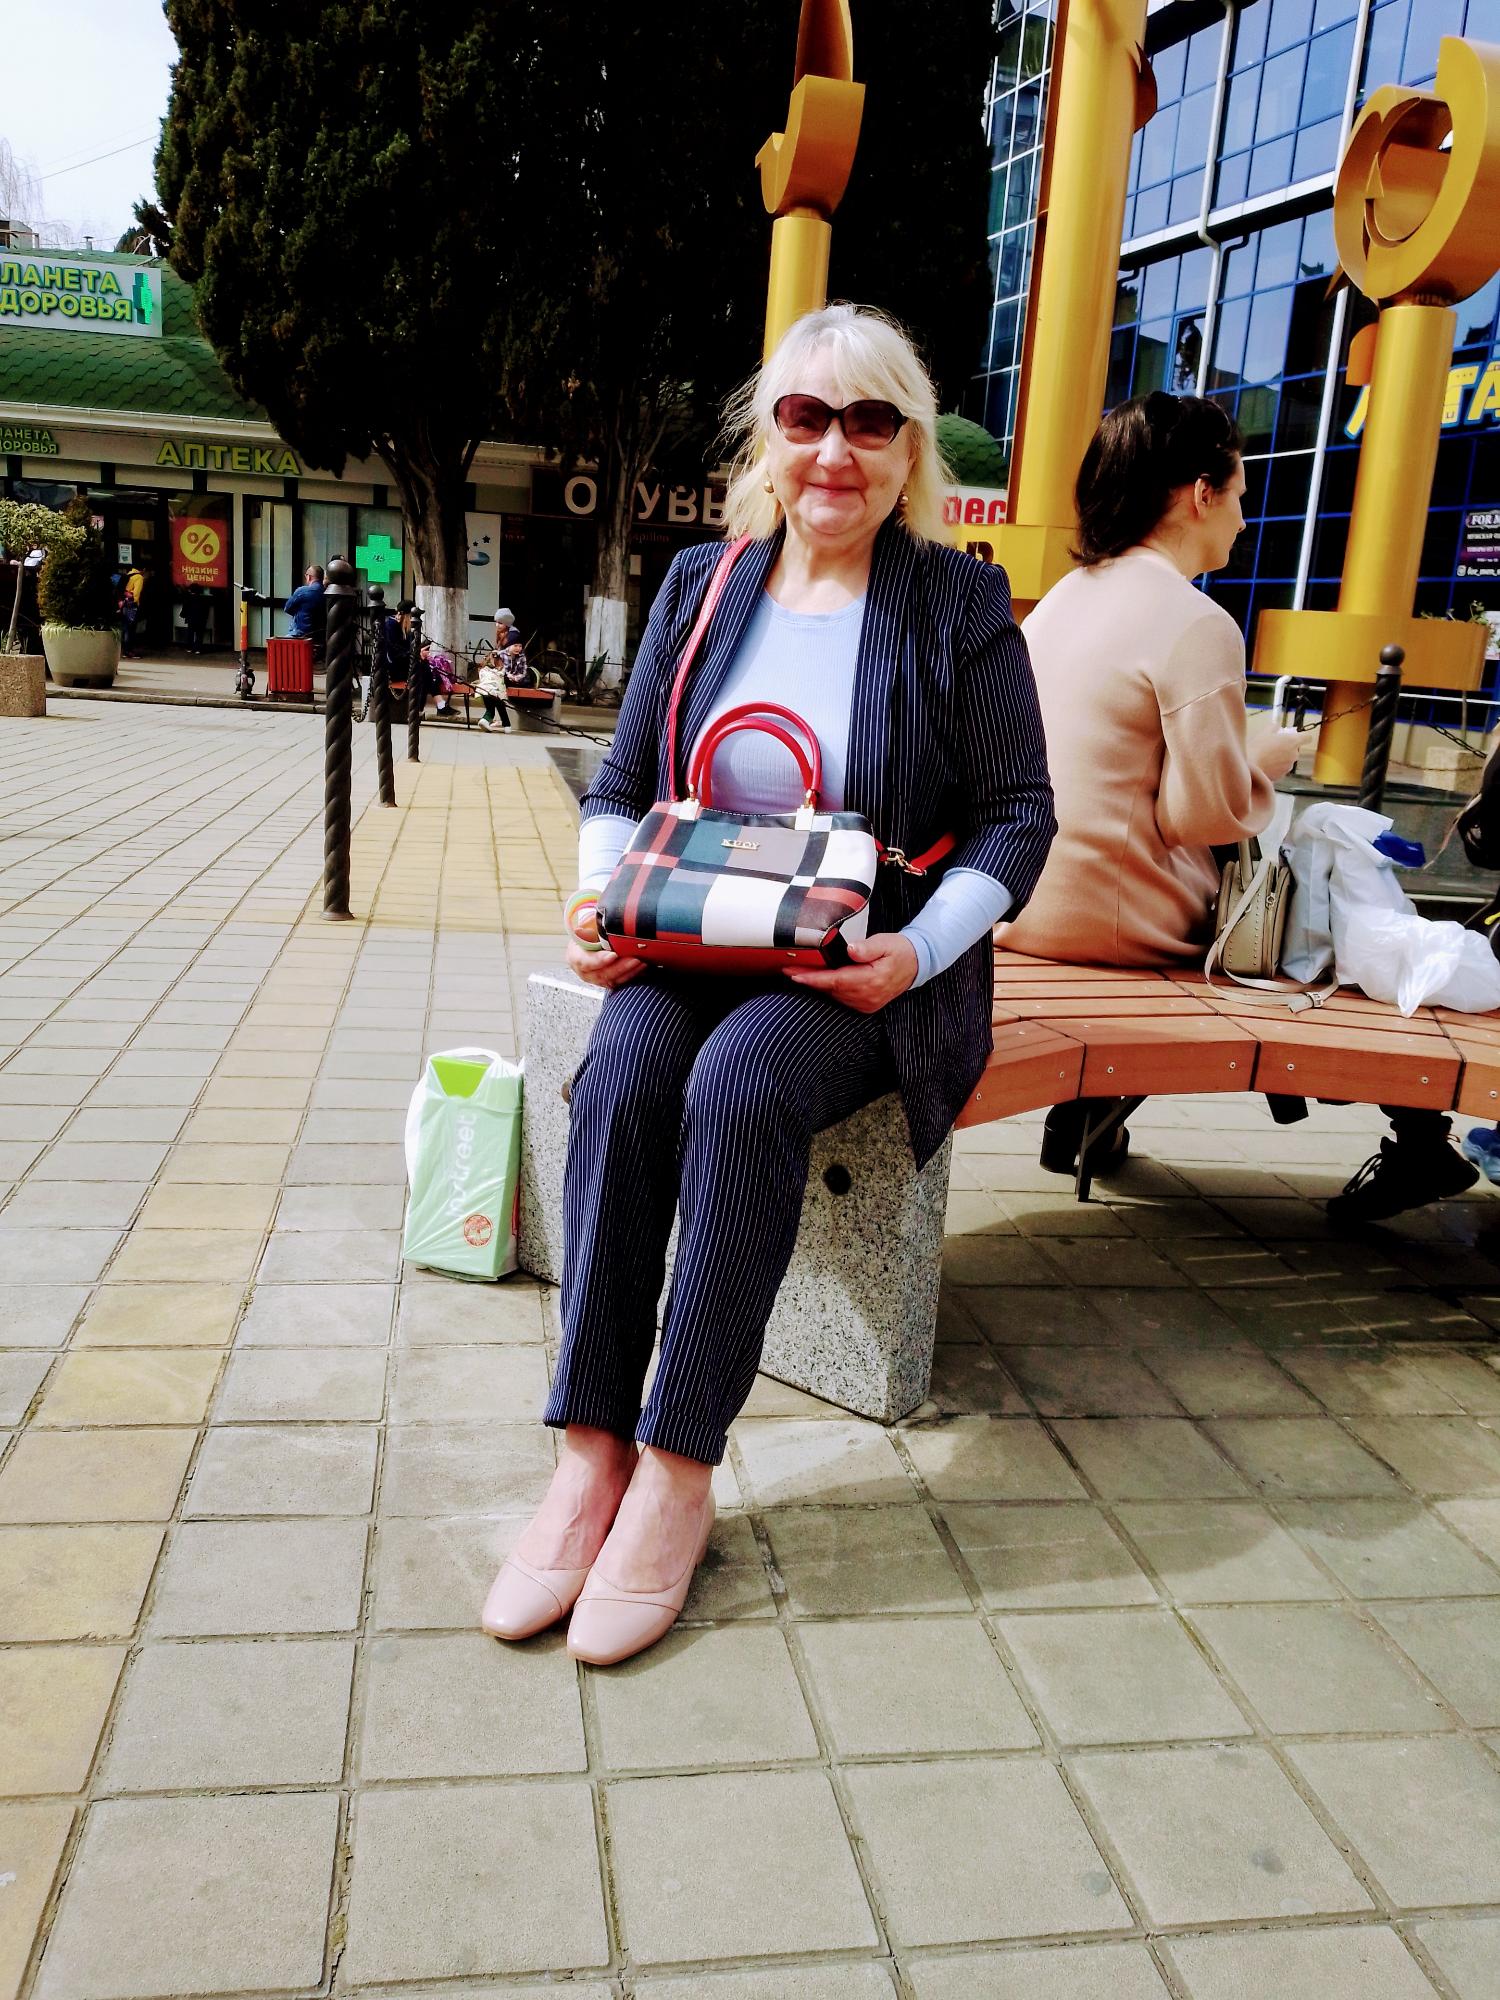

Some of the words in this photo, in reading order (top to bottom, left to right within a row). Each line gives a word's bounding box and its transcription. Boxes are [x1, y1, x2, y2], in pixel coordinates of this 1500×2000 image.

[0, 261, 122, 296] ЛАНЕТА
[0, 288, 133, 322] ДОРОВЬЯ
[0, 427, 52, 441] АНЕТА
[0, 440, 58, 455] ОРОВЬЯ
[156, 440, 302, 476] АПТЕКА
[564, 475, 726, 525] ОУВЬ
[181, 565, 219, 575] НИЗКИЕ
[187, 574, 214, 583] ЦЕНЫ
